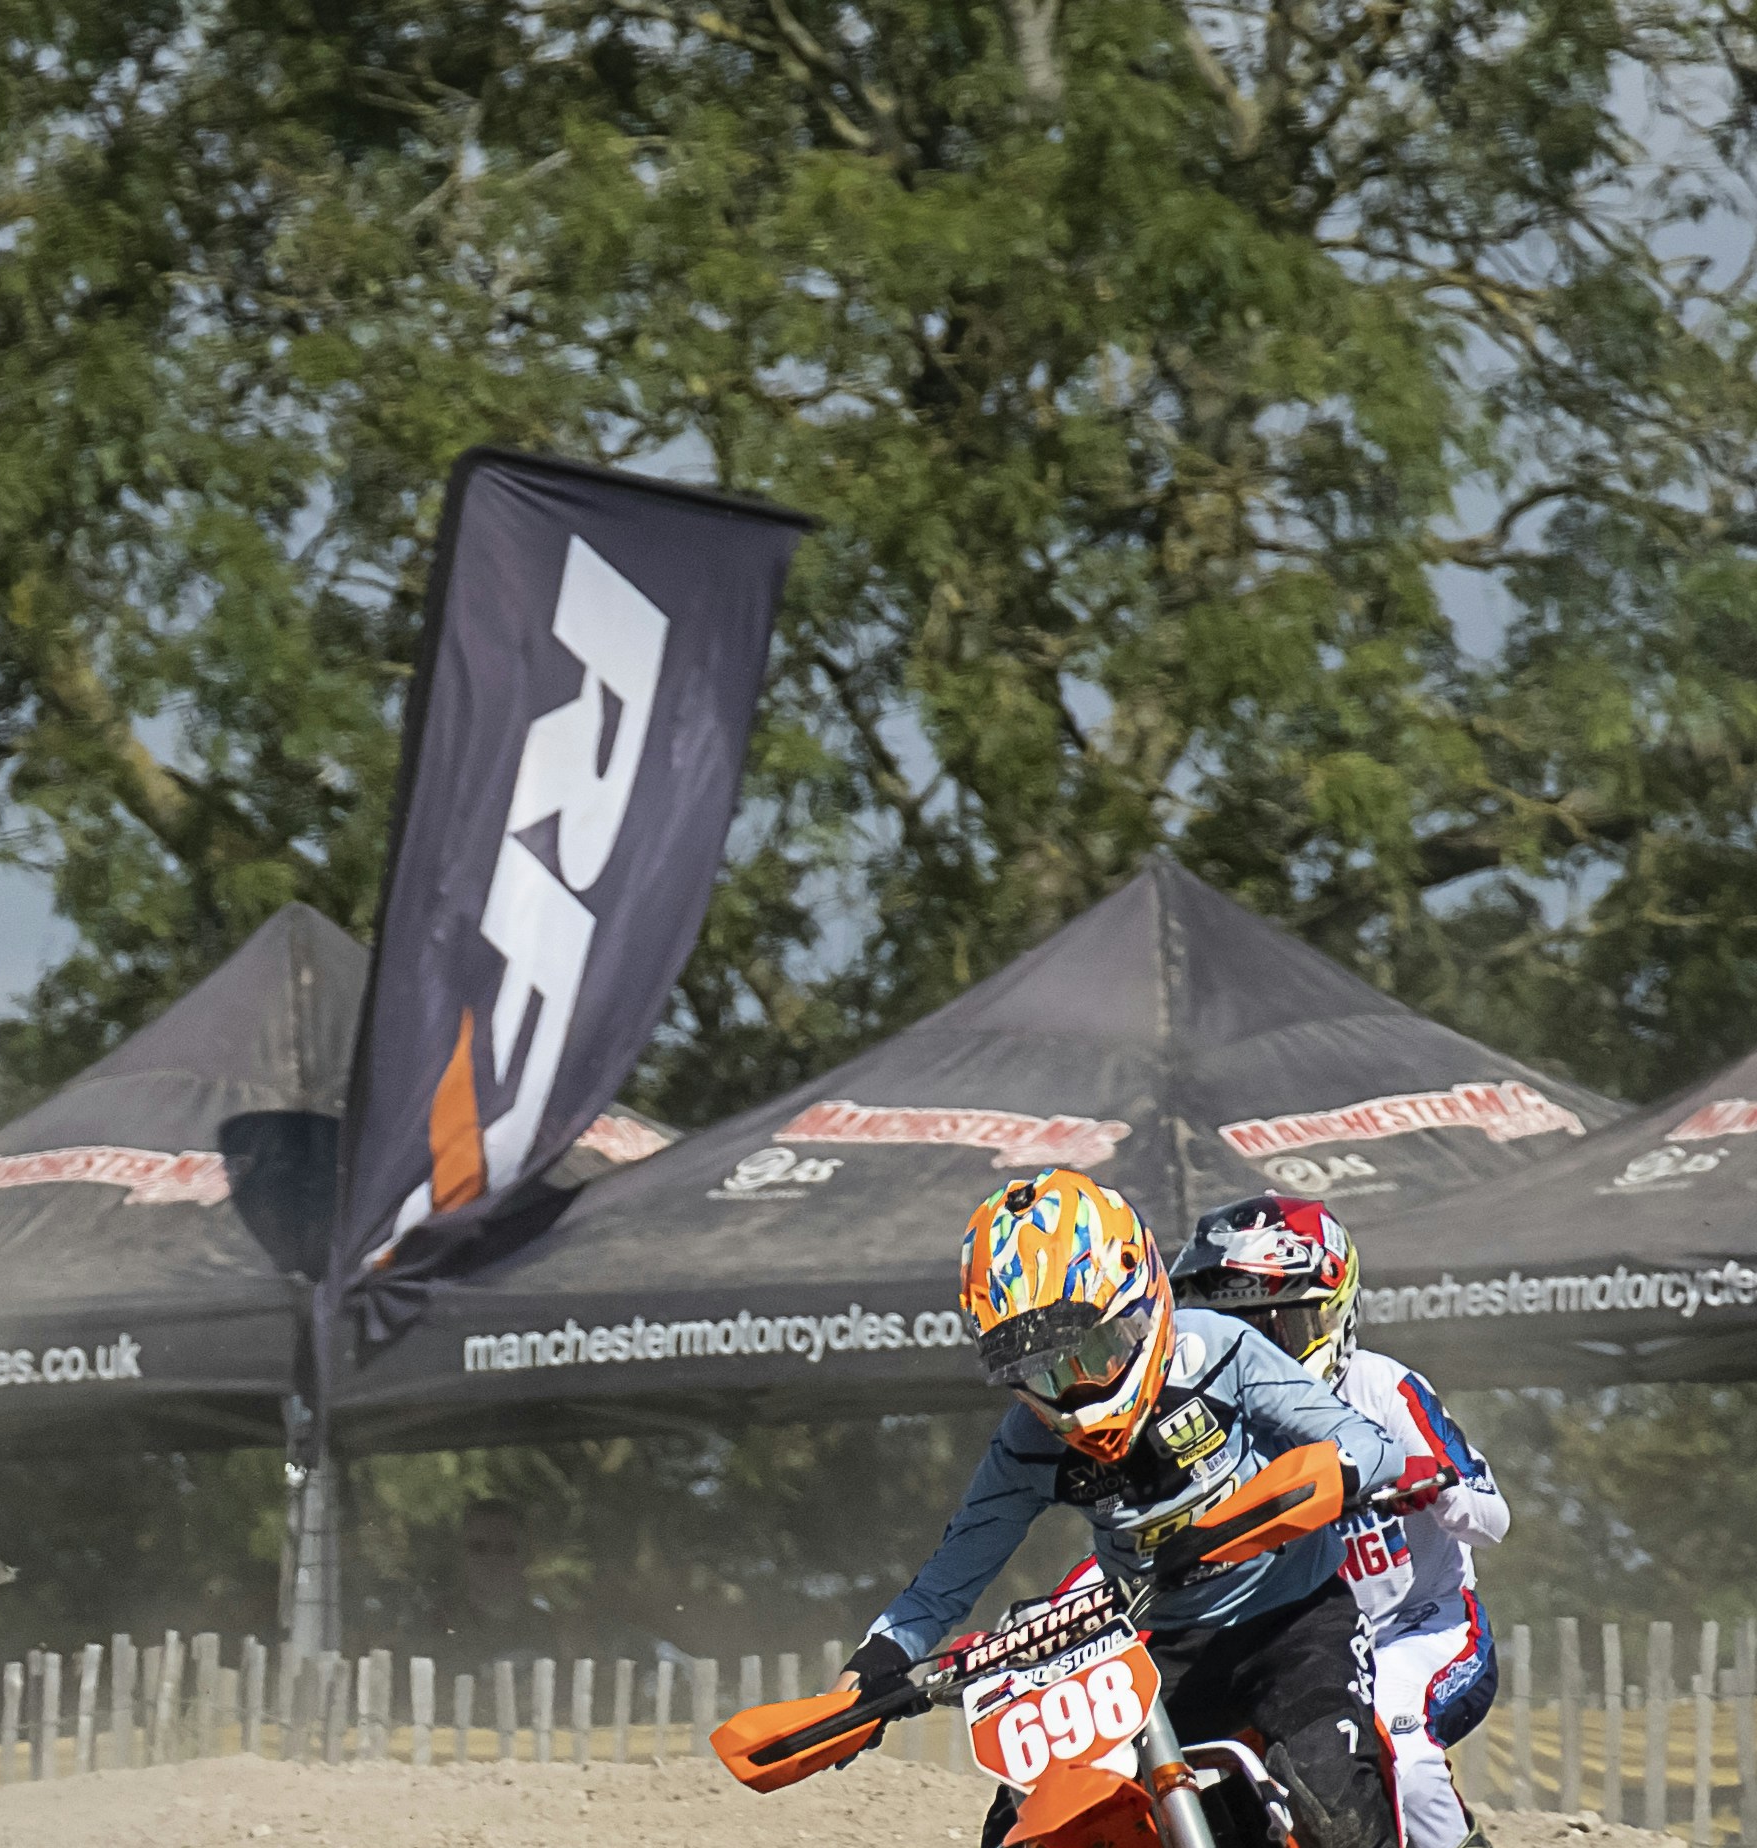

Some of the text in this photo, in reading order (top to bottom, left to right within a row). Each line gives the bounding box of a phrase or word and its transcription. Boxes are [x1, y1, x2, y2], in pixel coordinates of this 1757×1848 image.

[465, 1303, 974, 1372] manchestermotorcycles.co.
[966, 1587, 1114, 1672] RENTHAL
[997, 1659, 1144, 1784] 698
